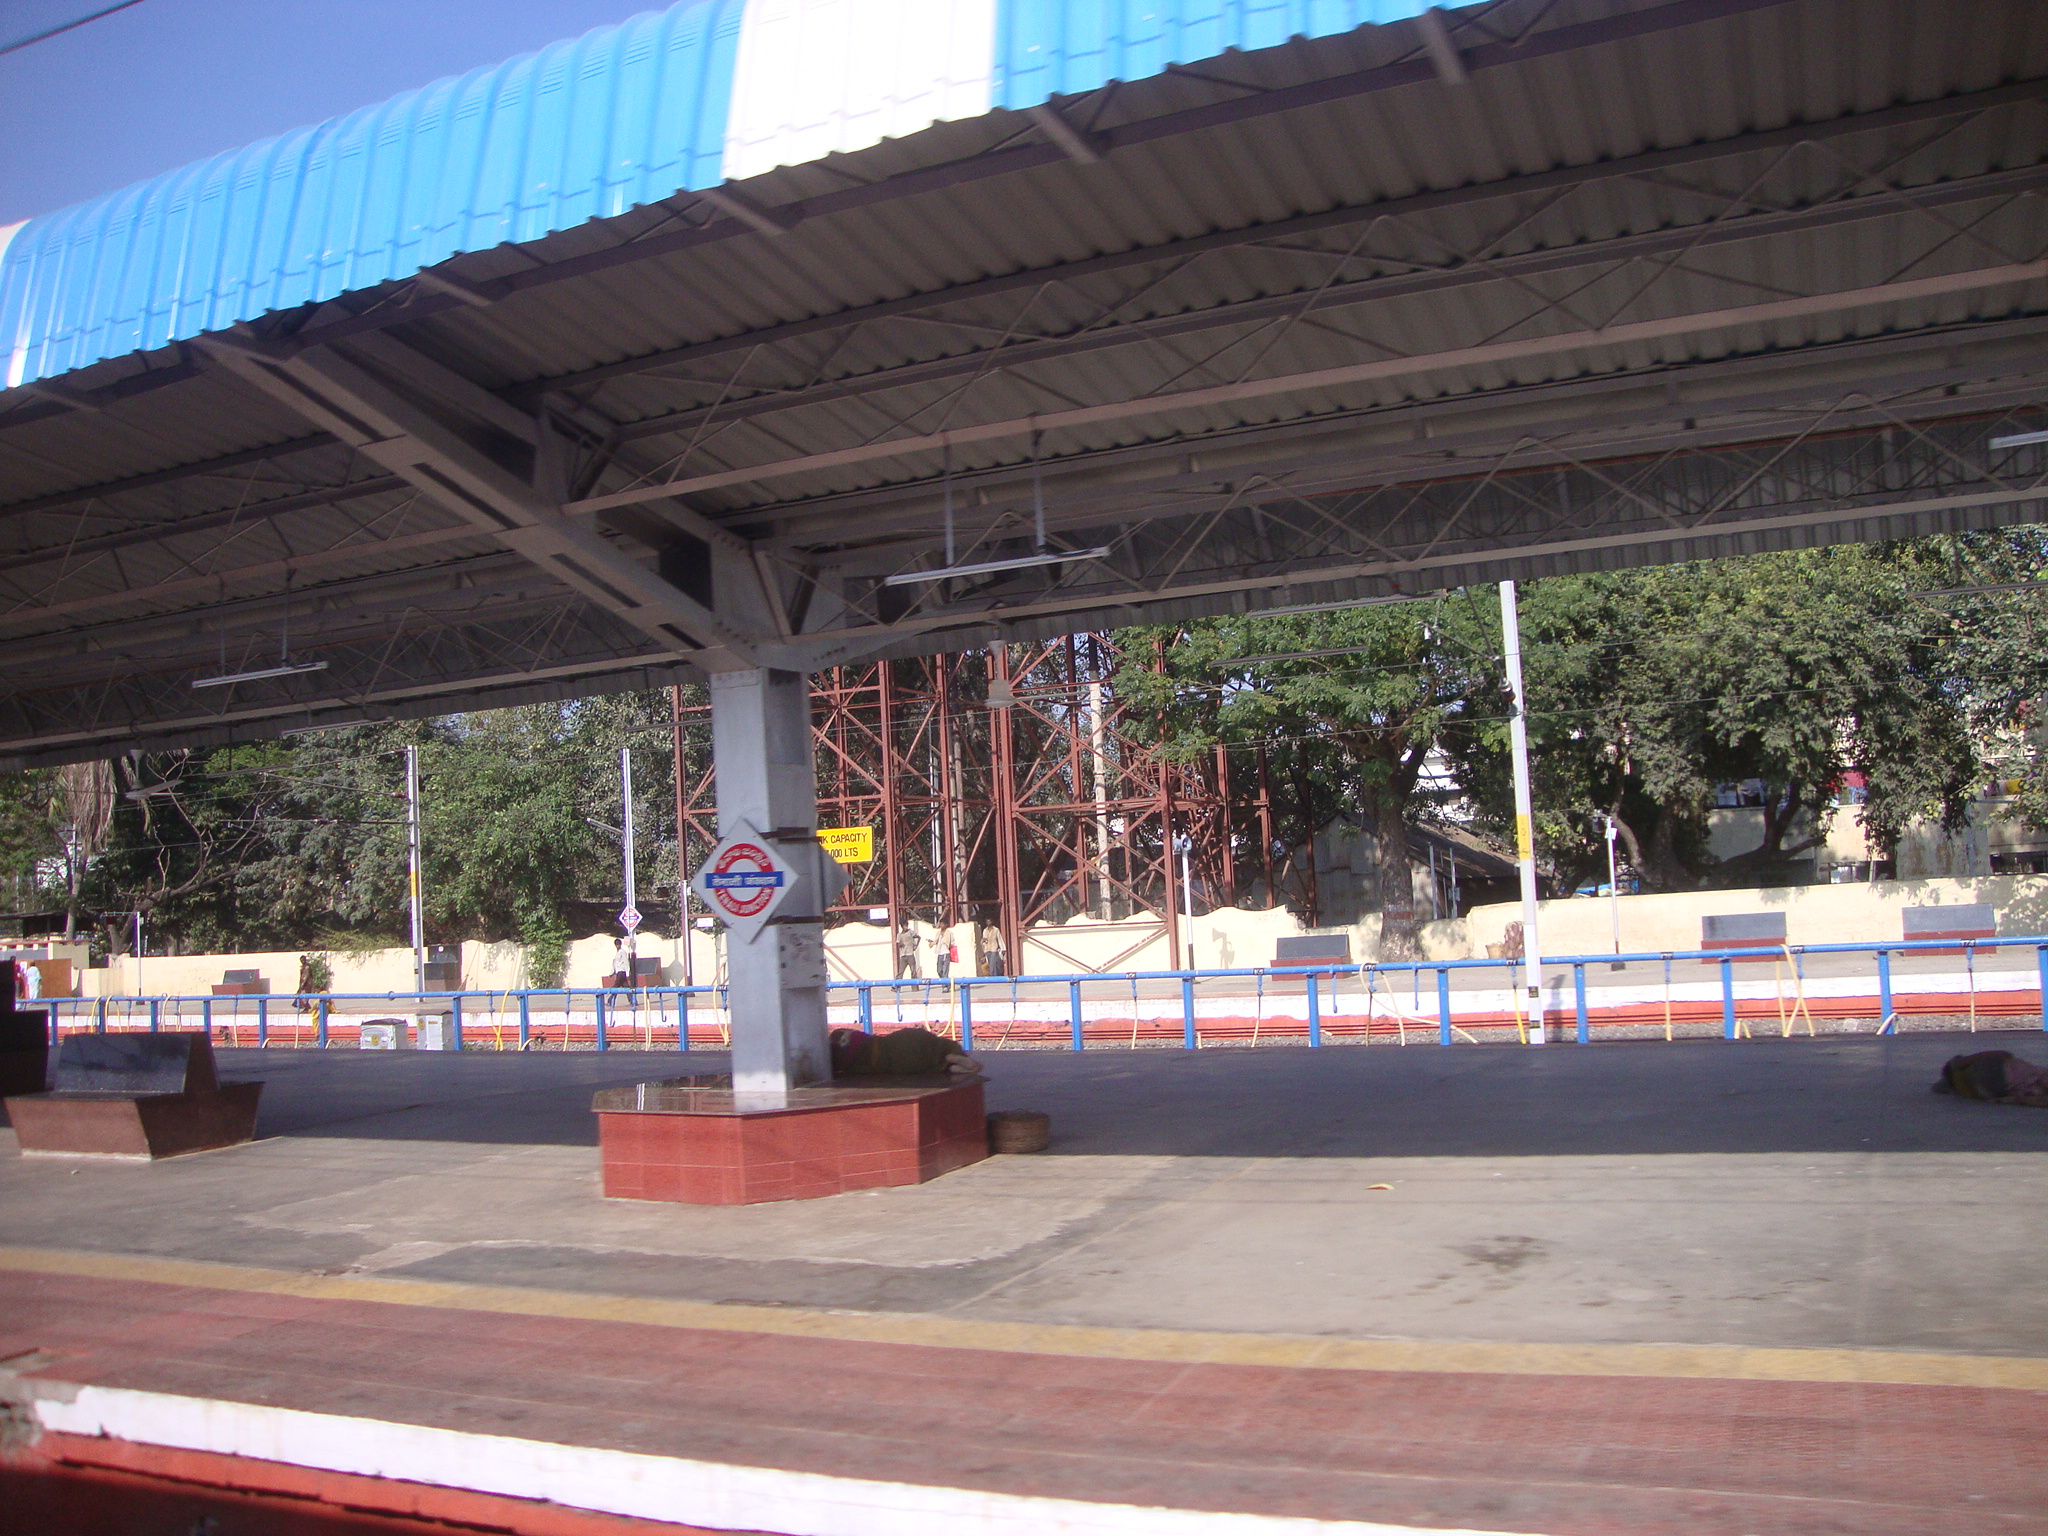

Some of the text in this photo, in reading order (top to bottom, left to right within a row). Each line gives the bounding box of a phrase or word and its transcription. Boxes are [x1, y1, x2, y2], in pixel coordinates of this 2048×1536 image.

[830, 832, 868, 844] CAPACITY
[844, 846, 859, 857] LTS
[738, 889, 772, 914] JUNCTION
